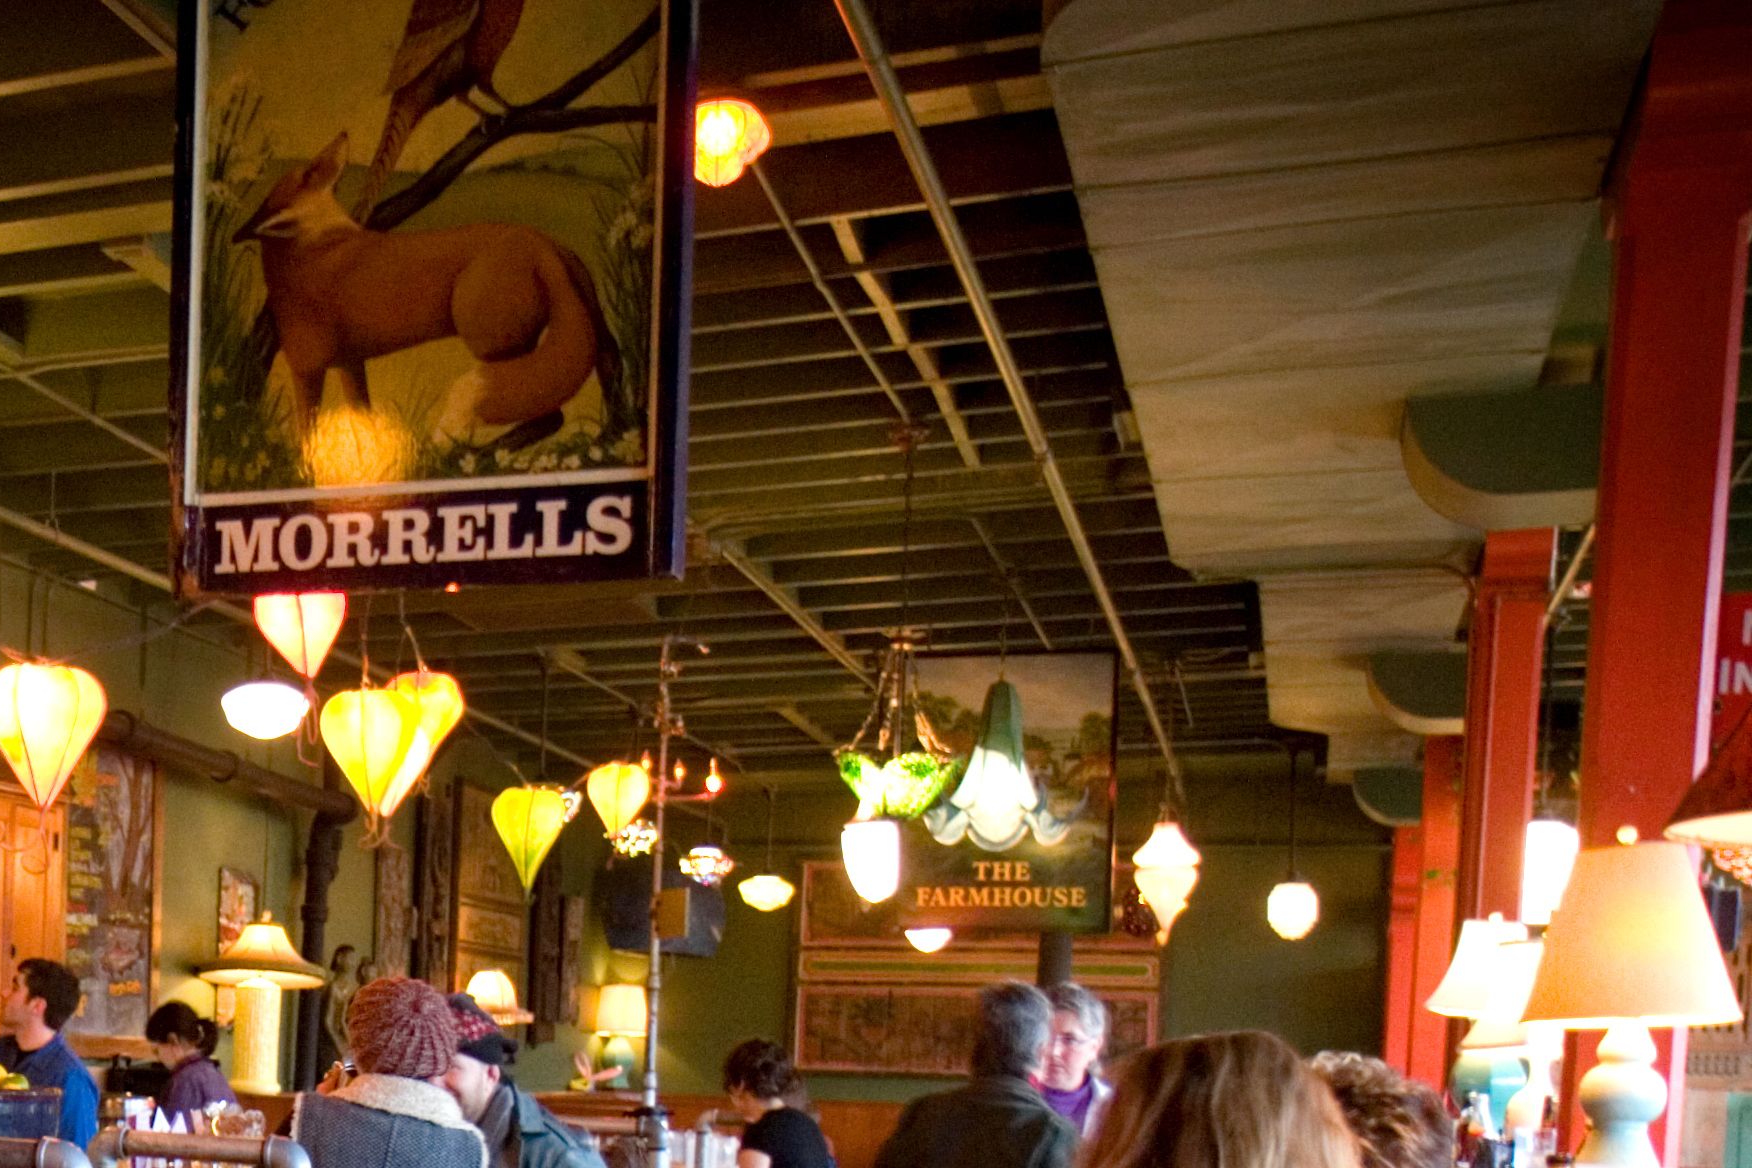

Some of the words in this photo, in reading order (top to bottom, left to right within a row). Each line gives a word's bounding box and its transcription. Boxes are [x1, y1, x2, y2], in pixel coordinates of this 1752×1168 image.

[214, 494, 634, 575] MORRELLS
[973, 860, 1031, 882] THE
[916, 886, 1086, 908] FARMHOUSE
